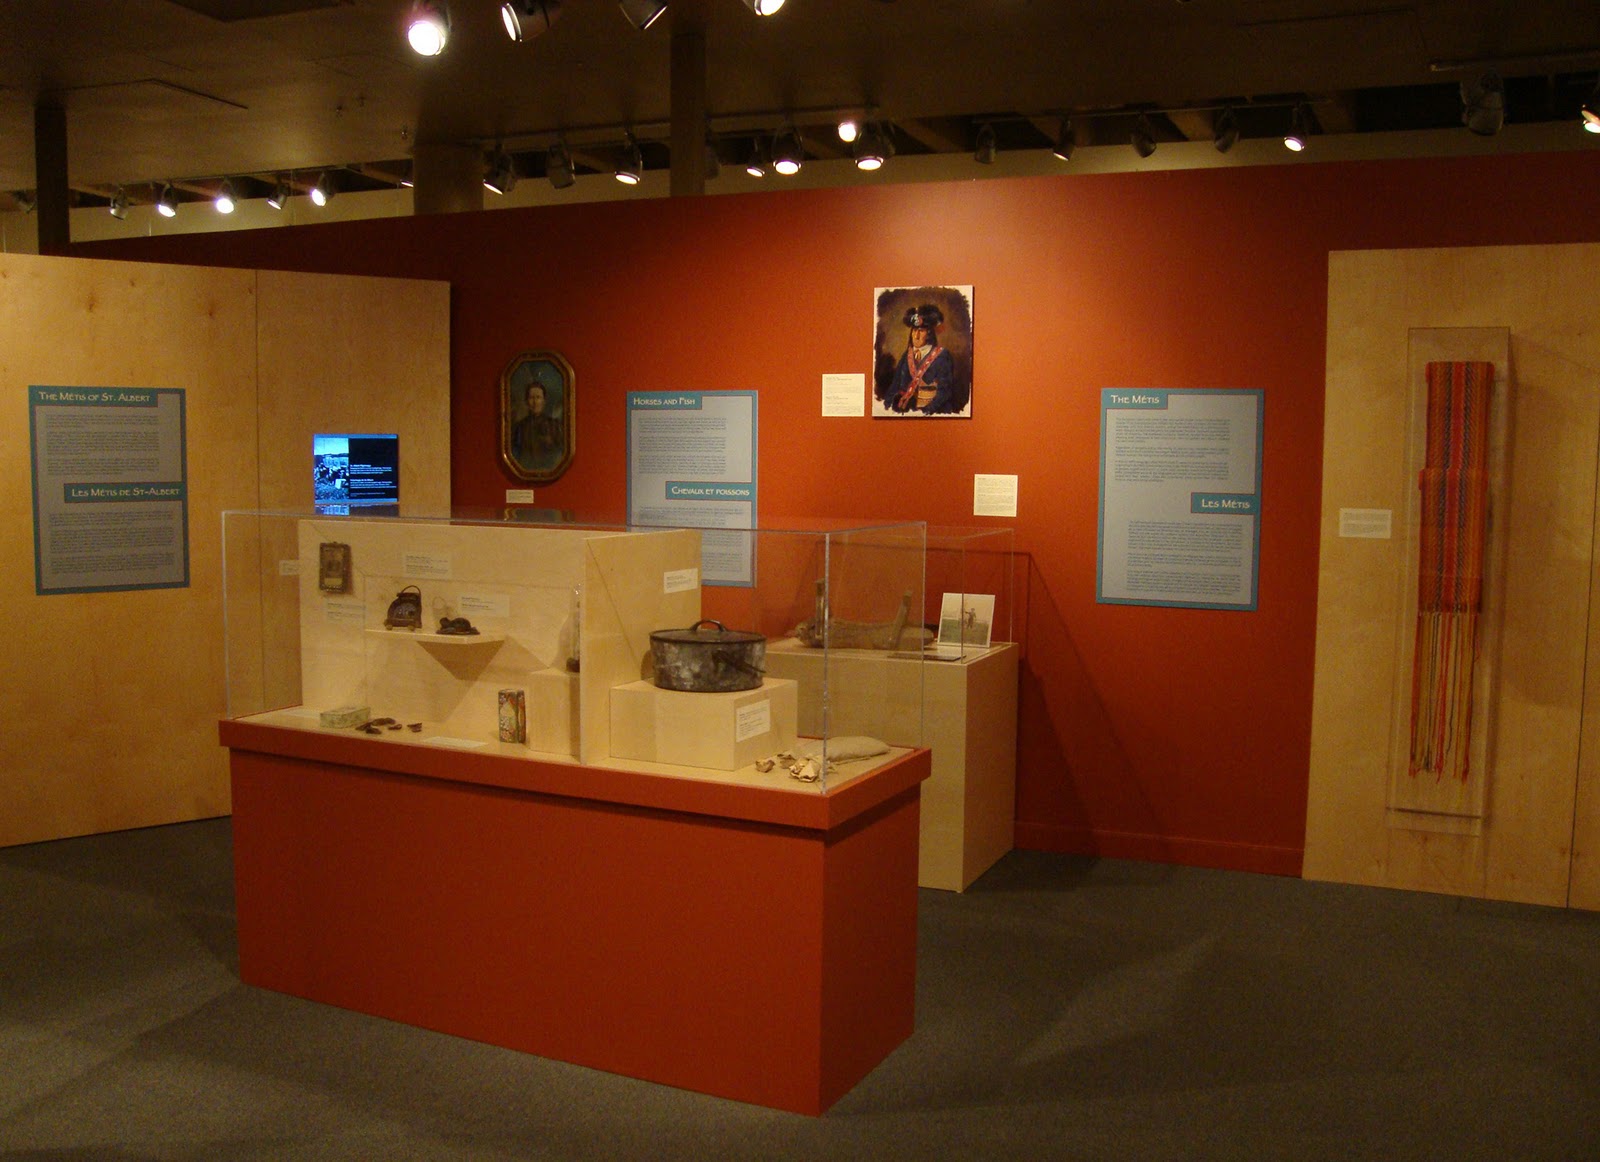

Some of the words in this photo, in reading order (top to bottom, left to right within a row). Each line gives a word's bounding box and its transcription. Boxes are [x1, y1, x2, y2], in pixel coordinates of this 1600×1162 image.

[38, 391, 57, 401] THE
[88, 393, 98, 401] OF
[118, 393, 151, 402] ALBERT
[633, 397, 662, 405] HORSES
[679, 396, 696, 405] FISH
[1110, 394, 1130, 404] THE
[71, 488, 89, 497] LES
[671, 486, 704, 495] CHEVAUX
[716, 488, 750, 496] POISSONS
[1201, 498, 1220, 508] LES
